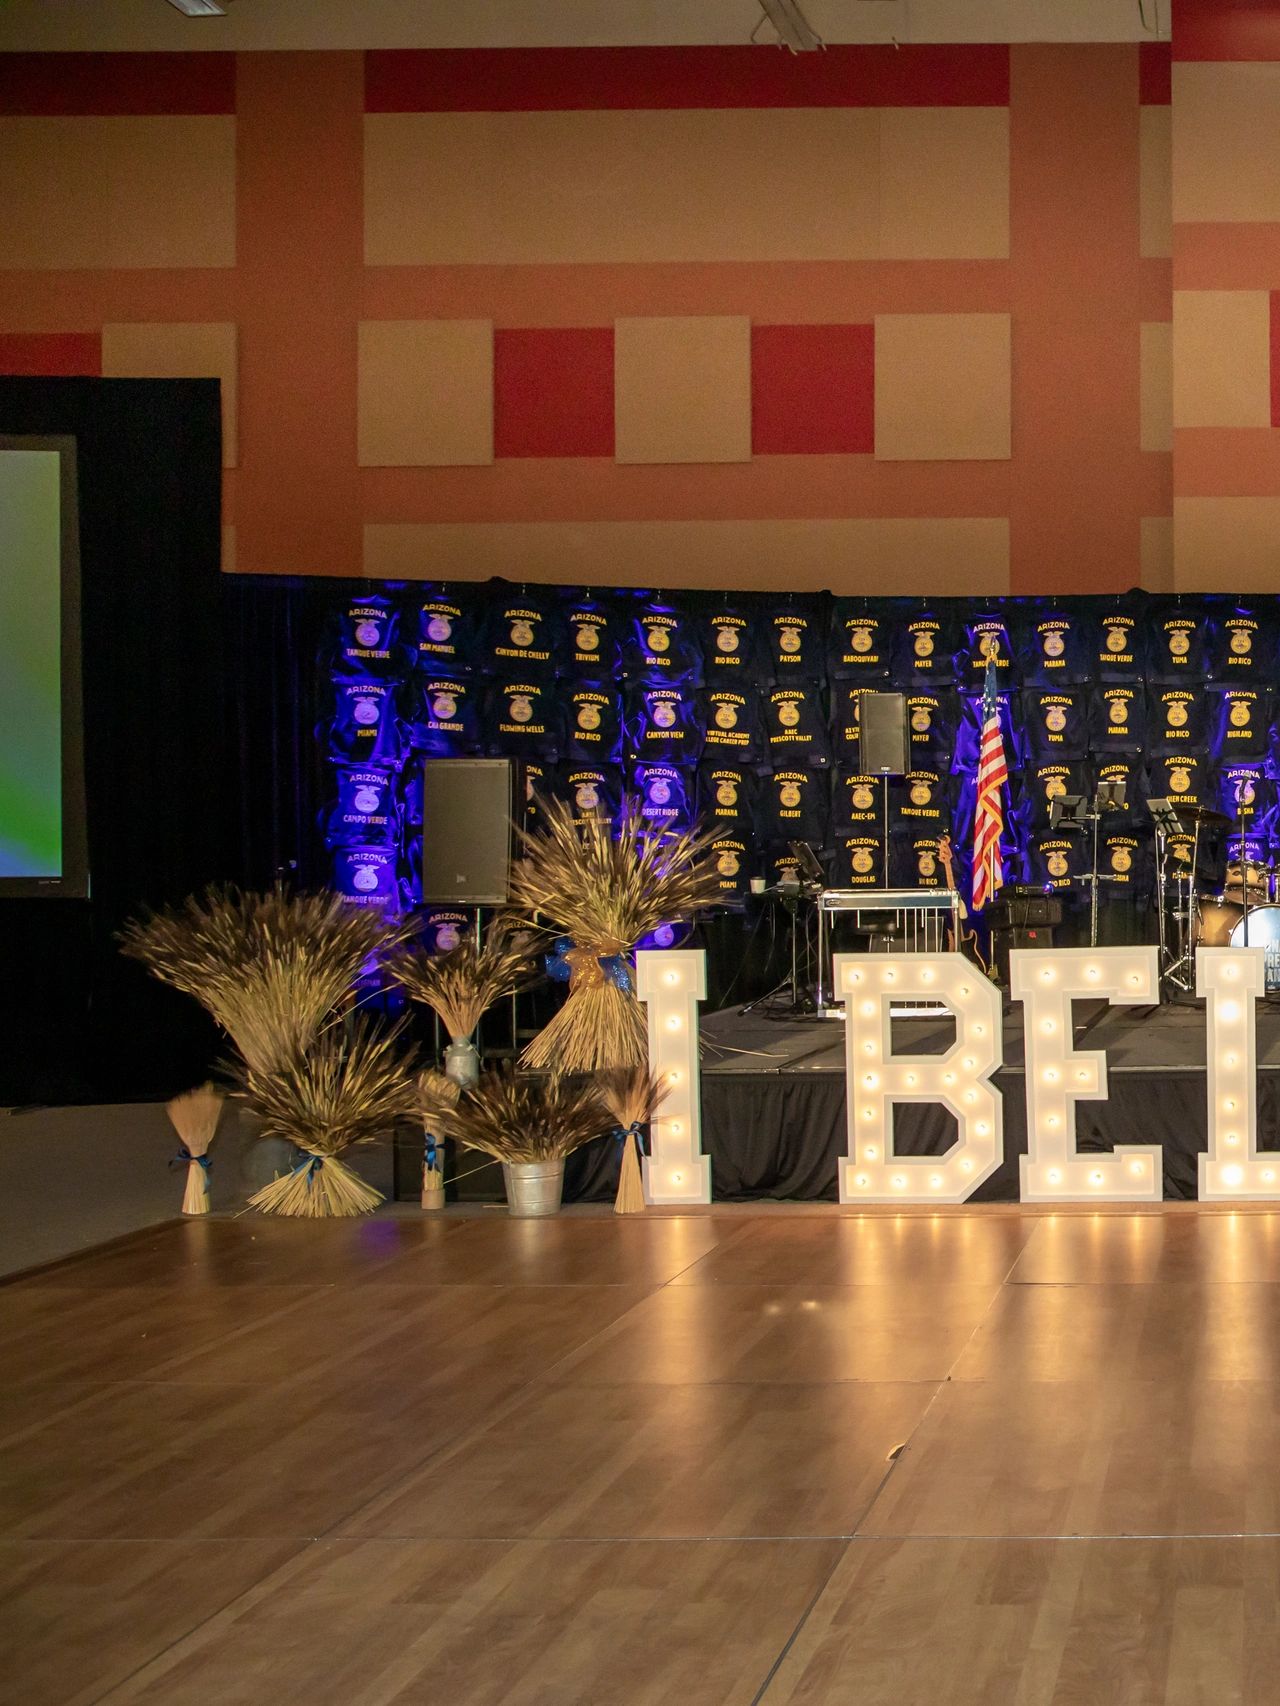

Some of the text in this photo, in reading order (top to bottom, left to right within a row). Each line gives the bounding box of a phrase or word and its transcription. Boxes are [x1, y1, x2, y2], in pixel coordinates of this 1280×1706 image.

[349, 608, 387, 619] ARIZONA
[504, 610, 542, 622] ARIZONA
[642, 616, 678, 627] ARIZONA
[774, 617, 807, 627] ARIZONA
[1103, 617, 1135, 627] ARIZONA
[1225, 620, 1258, 629] ARIZONA
[908, 622, 941, 632] ARIZONA
[420, 643, 430, 651] SAN
[530, 650, 550, 660] CHELLY
[576, 654, 599, 662] TRIVIUM
[657, 657, 671, 665] RICO
[1239, 657, 1251, 665] RICO
[346, 685, 386, 695] ARIZONA
[504, 685, 541, 695] ARIZONA
[1104, 689, 1134, 699] ARIZONA
[647, 691, 681, 700] ARIZONA
[771, 692, 805, 703] ARIZONA
[439, 722, 464, 731] GRANDE
[526, 725, 544, 733] WELLS
[575, 732, 601, 741] RIO RICO
[647, 731, 668, 739] CANYON
[912, 734, 929, 742] MAYER
[1166, 730, 1175, 738] RIO
[1165, 757, 1197, 767] ARIZONA
[712, 771, 742, 782] ARIZONA
[1037, 767, 1070, 777] ARIZONA
[569, 773, 605, 782] ARIZONA
[846, 776, 879, 785] ARIZONA
[642, 808, 661, 816] DESERT
[922, 809, 939, 817] VERDE
[343, 815, 388, 825] CAMPO VERDE
[846, 838, 879, 847] ARIZONA
[1107, 838, 1138, 848] ARIZONA
[347, 854, 387, 864] ARIZONA
[636, 949, 712, 1205] I
